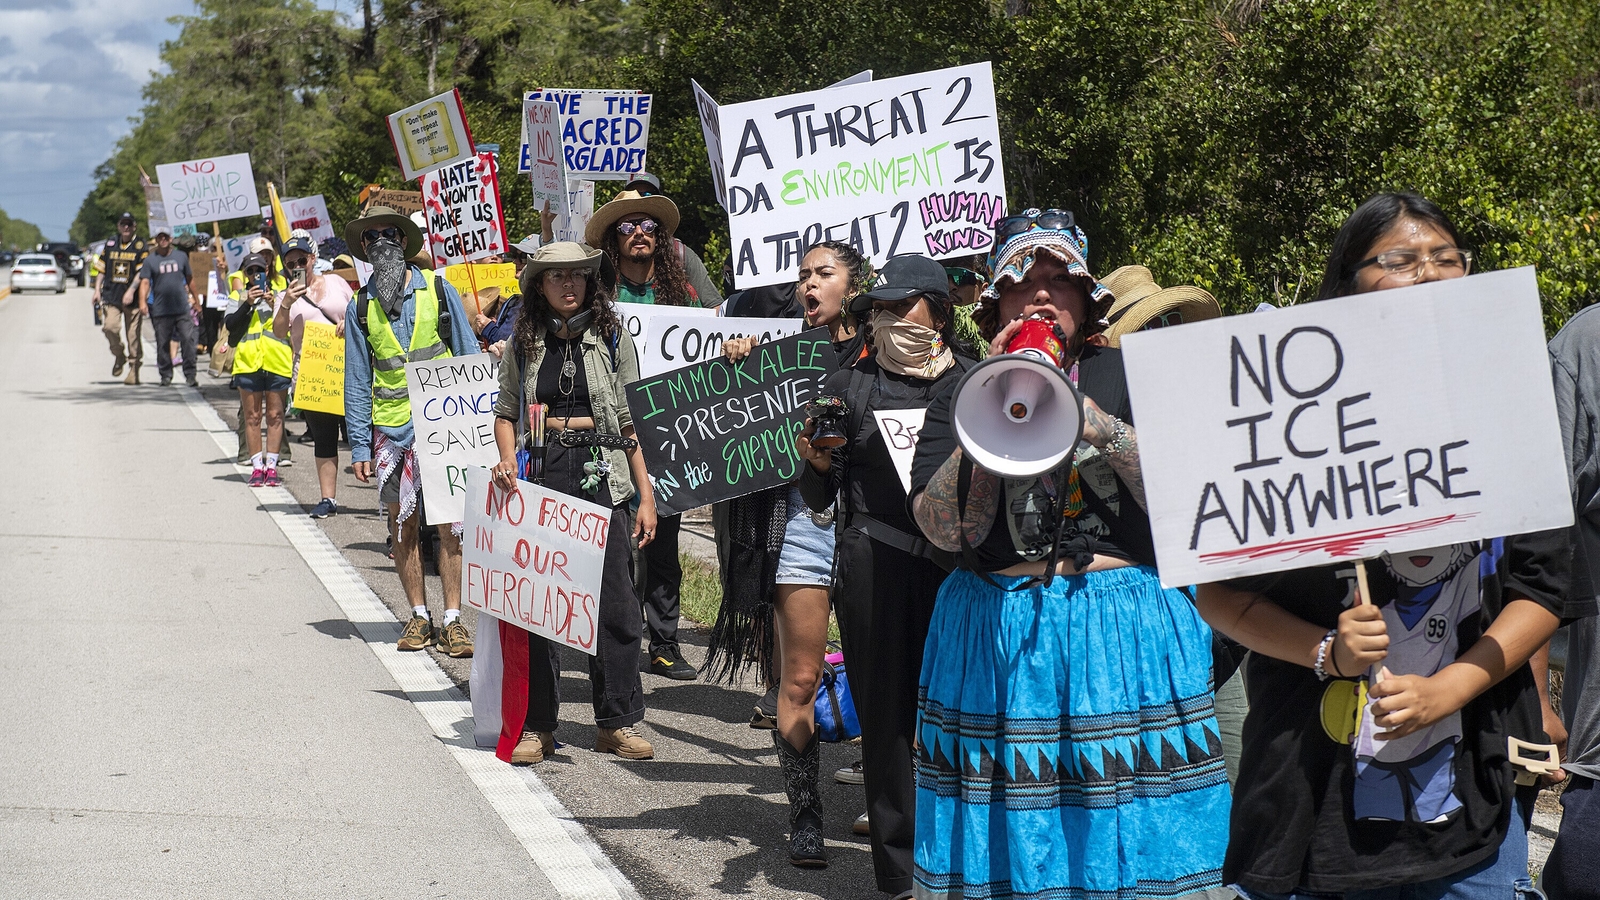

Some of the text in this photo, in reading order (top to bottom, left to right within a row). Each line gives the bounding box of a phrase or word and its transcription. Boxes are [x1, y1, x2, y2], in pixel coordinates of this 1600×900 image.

[423, 109, 438, 120] make
[528, 104, 552, 124] WE SAY
[604, 96, 650, 115] THE
[411, 120, 438, 136] me repeat
[562, 117, 643, 145] ACRED
[730, 119, 774, 178] A
[775, 87, 932, 159] THREAT
[942, 77, 991, 126] 2
[520, 143, 645, 172] ERGLADES
[537, 127, 555, 162] NO
[182, 160, 215, 176] NO
[439, 160, 477, 190] HATE
[729, 137, 995, 216] DA ENVIRONMENT IS
[171, 171, 241, 202] SWAMP
[440, 184, 478, 207] WON'T
[174, 194, 248, 219] GESTAPO
[431, 207, 462, 234] MAKE
[472, 203, 493, 222] US
[443, 228, 487, 257] GREAT
[736, 238, 760, 276] A
[886, 201, 924, 260] 2
[924, 226, 993, 257] KIND
[450, 267, 516, 281] DO JUST
[304, 349, 344, 364] SPEAK FOR
[308, 339, 332, 349] THOSE
[300, 373, 325, 385] SILENCE
[415, 362, 500, 393] REMOV
[635, 340, 830, 420] IMMOKALEE
[1230, 326, 1344, 407] NO
[299, 384, 306, 394] IT
[320, 386, 341, 396] FAILURE
[674, 378, 811, 449] PRESENTE
[427, 424, 495, 456] SAVE
[1226, 392, 1381, 472] ICE
[656, 469, 680, 501] IN
[684, 460, 712, 490] the
[1188, 439, 1481, 551] ANYWHERE
[486, 480, 525, 527] NO
[537, 497, 608, 549] FASCISTS
[475, 524, 573, 582] IN OUR
[468, 562, 596, 649] EVERGLADES
[1427, 617, 1447, 639] 99
